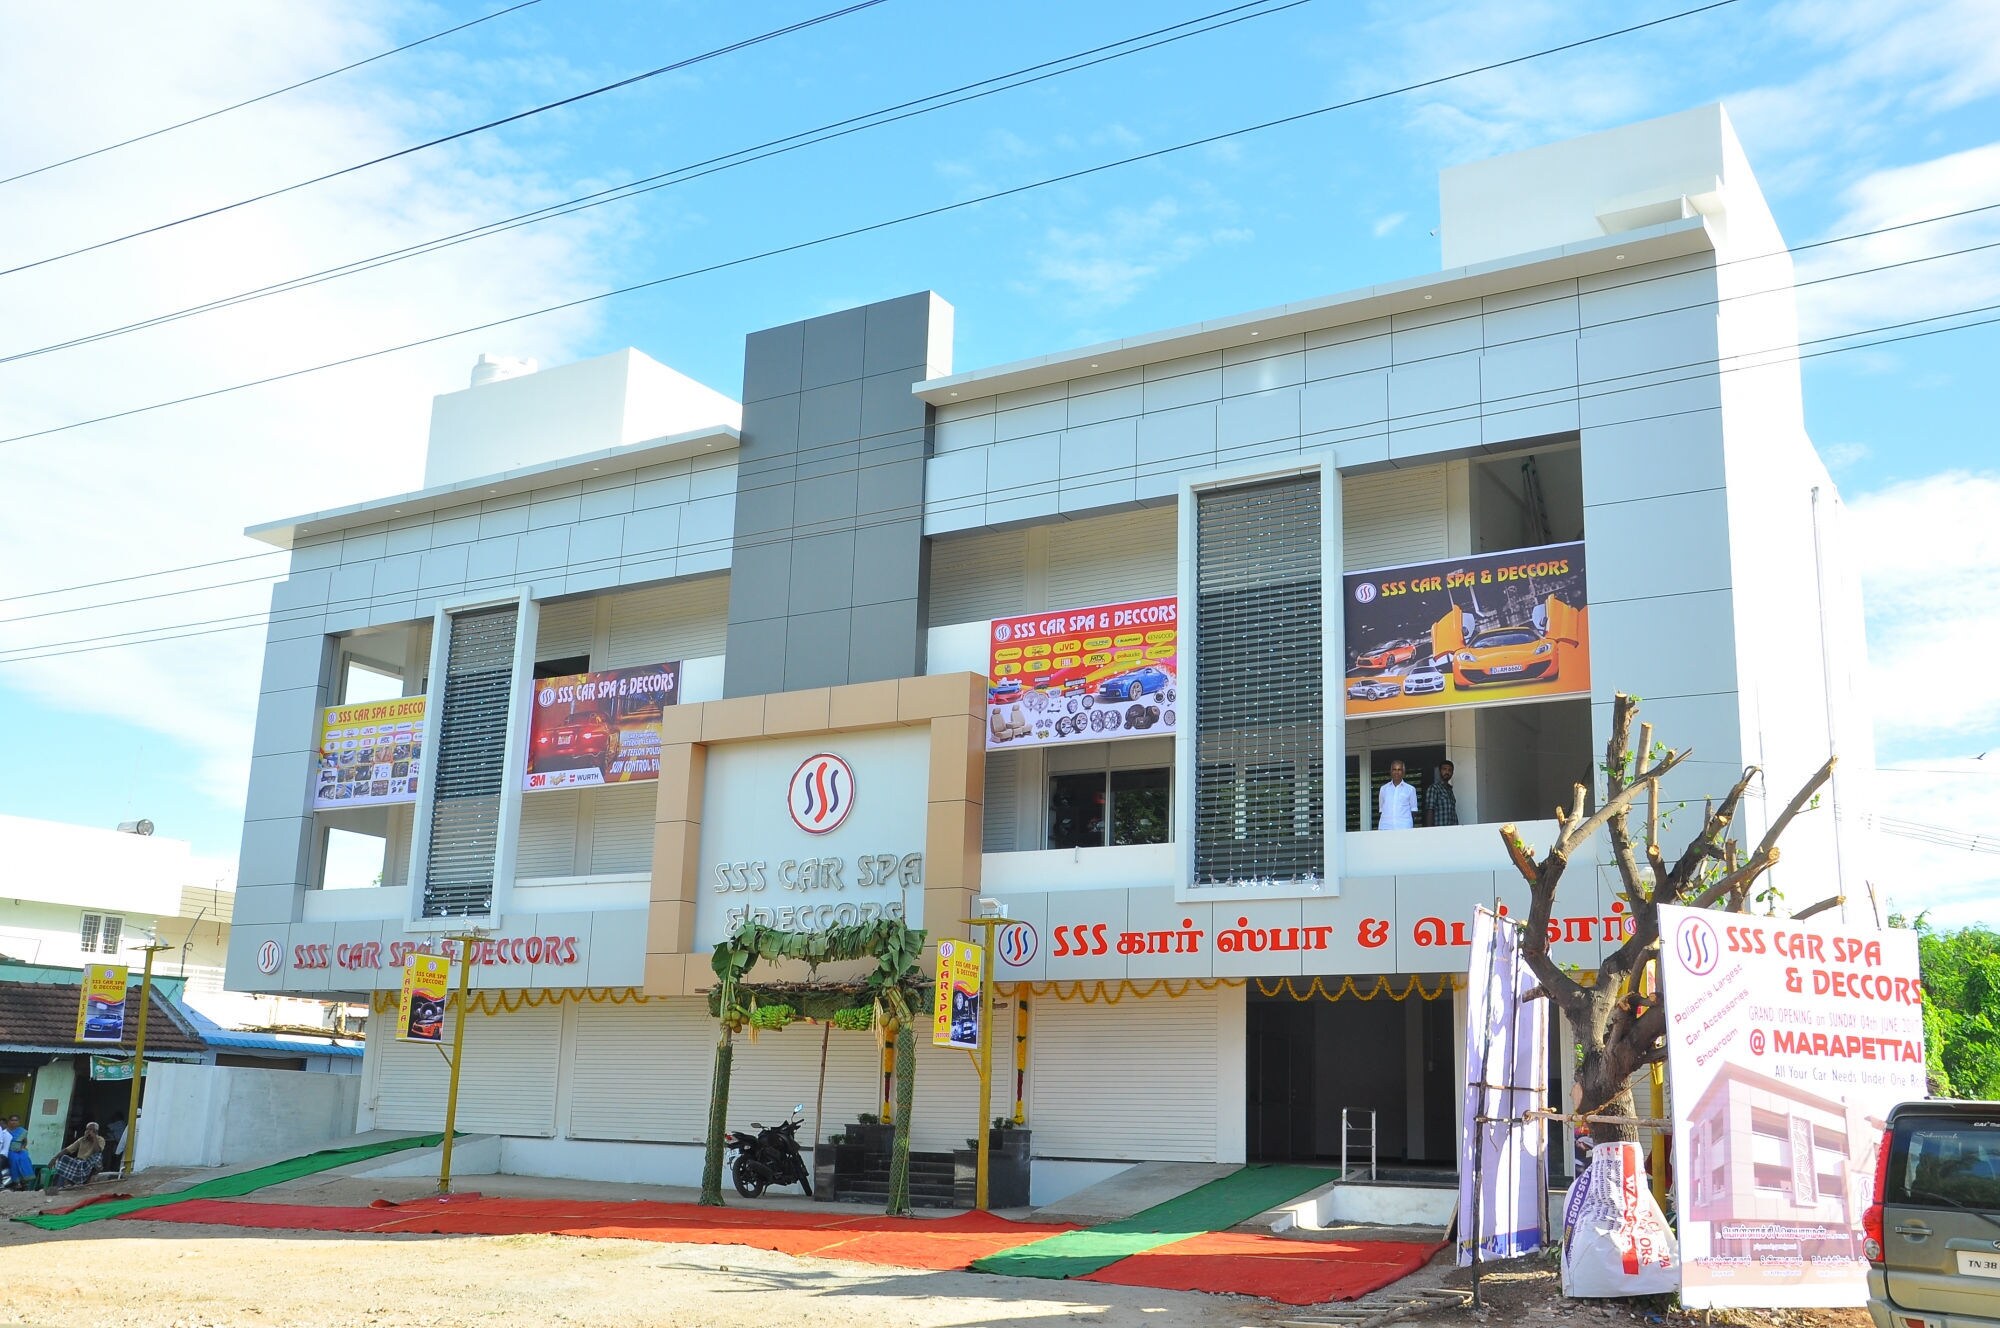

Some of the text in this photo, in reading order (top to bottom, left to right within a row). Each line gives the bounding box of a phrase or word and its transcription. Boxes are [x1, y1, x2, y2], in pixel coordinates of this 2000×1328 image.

[1381, 581, 1407, 597] SSS
[1411, 576, 1442, 593] CAR
[1446, 570, 1475, 589] SPA
[1480, 569, 1492, 584] &
[1497, 559, 1568, 582] DECCORS
[1014, 623, 1036, 639] SSS
[1039, 620, 1066, 636] CAR
[1069, 614, 1095, 632] SPA
[1100, 612, 1110, 628] &
[1114, 604, 1177, 627] DECCORS
[1059, 643, 1075, 652] JVC
[557, 686, 573, 703] SSS
[576, 682, 597, 702] CAR
[598, 679, 617, 699] SPA
[619, 678, 628, 696] &
[629, 673, 674, 695] DECCORS
[338, 710, 352, 723] SSS
[354, 708, 370, 721] CAR
[372, 706, 387, 719] SPA
[389, 705, 395, 717] &
[529, 774, 546, 787] 3M
[624, 759, 651, 772] CONTROL
[713, 852, 922, 893] SSS CAR SPA
[724, 907, 744, 938] &
[1116, 916, 1333, 955] கார் ஸ்பா
[1357, 917, 1388, 948] &
[293, 943, 331, 970] SSS
[336, 940, 382, 971] CAR
[469, 936, 579, 966] DECCORS
[1052, 923, 1110, 957] SSS
[1726, 926, 1767, 955] SSS
[1773, 931, 1827, 964] CAR
[1832, 937, 1881, 968] SPA
[1711, 964, 1744, 993] Largest
[1785, 967, 1922, 1007] & DECCORS
[1685, 988, 1750, 1046] Car Accessories
[1748, 1006, 1774, 1022] GRAND
[1779, 1007, 1812, 1025] OPENING
[1816, 1015, 1826, 1026] on
[1829, 1012, 1856, 1029] SUNDAY
[1881, 1016, 1898, 1034] JUNE
[1696, 1028, 1739, 1067] Showroom
[1749, 1028, 1922, 1063] @ MARAPETTAI
[1775, 1065, 1786, 1078] All
[1789, 1065, 1808, 1080] Your
[1812, 1066, 1827, 1081] Car
[1832, 1069, 1857, 1083] Needs
[1861, 1071, 1886, 1085] Under
[1890, 1072, 1906, 1087] One
[1968, 1260, 1998, 1269] TN 38
